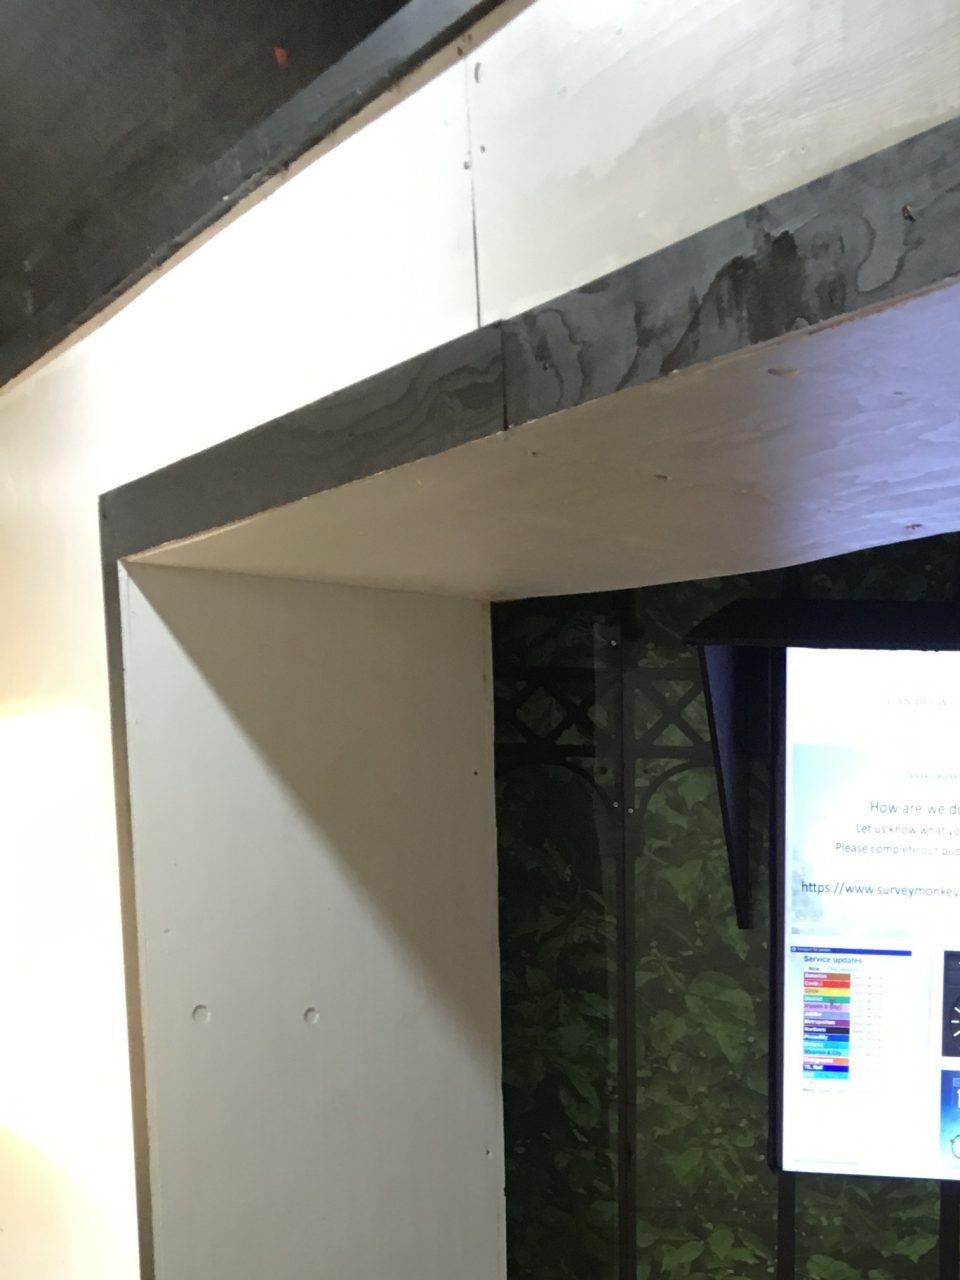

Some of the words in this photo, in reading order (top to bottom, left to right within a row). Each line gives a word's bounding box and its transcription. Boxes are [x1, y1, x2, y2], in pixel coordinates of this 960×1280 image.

[870, 801, 898, 814] How
[903, 804, 922, 814] are
[928, 804, 945, 815] we
[856, 824, 871, 834] Let
[875, 826, 885, 834] us
[889, 825, 917, 835] know
[920, 825, 945, 836] what
[835, 842, 868, 854] Please
[870, 844, 919, 857] complete
[804, 955, 831, 964] Service
[833, 956, 862, 966] updates
